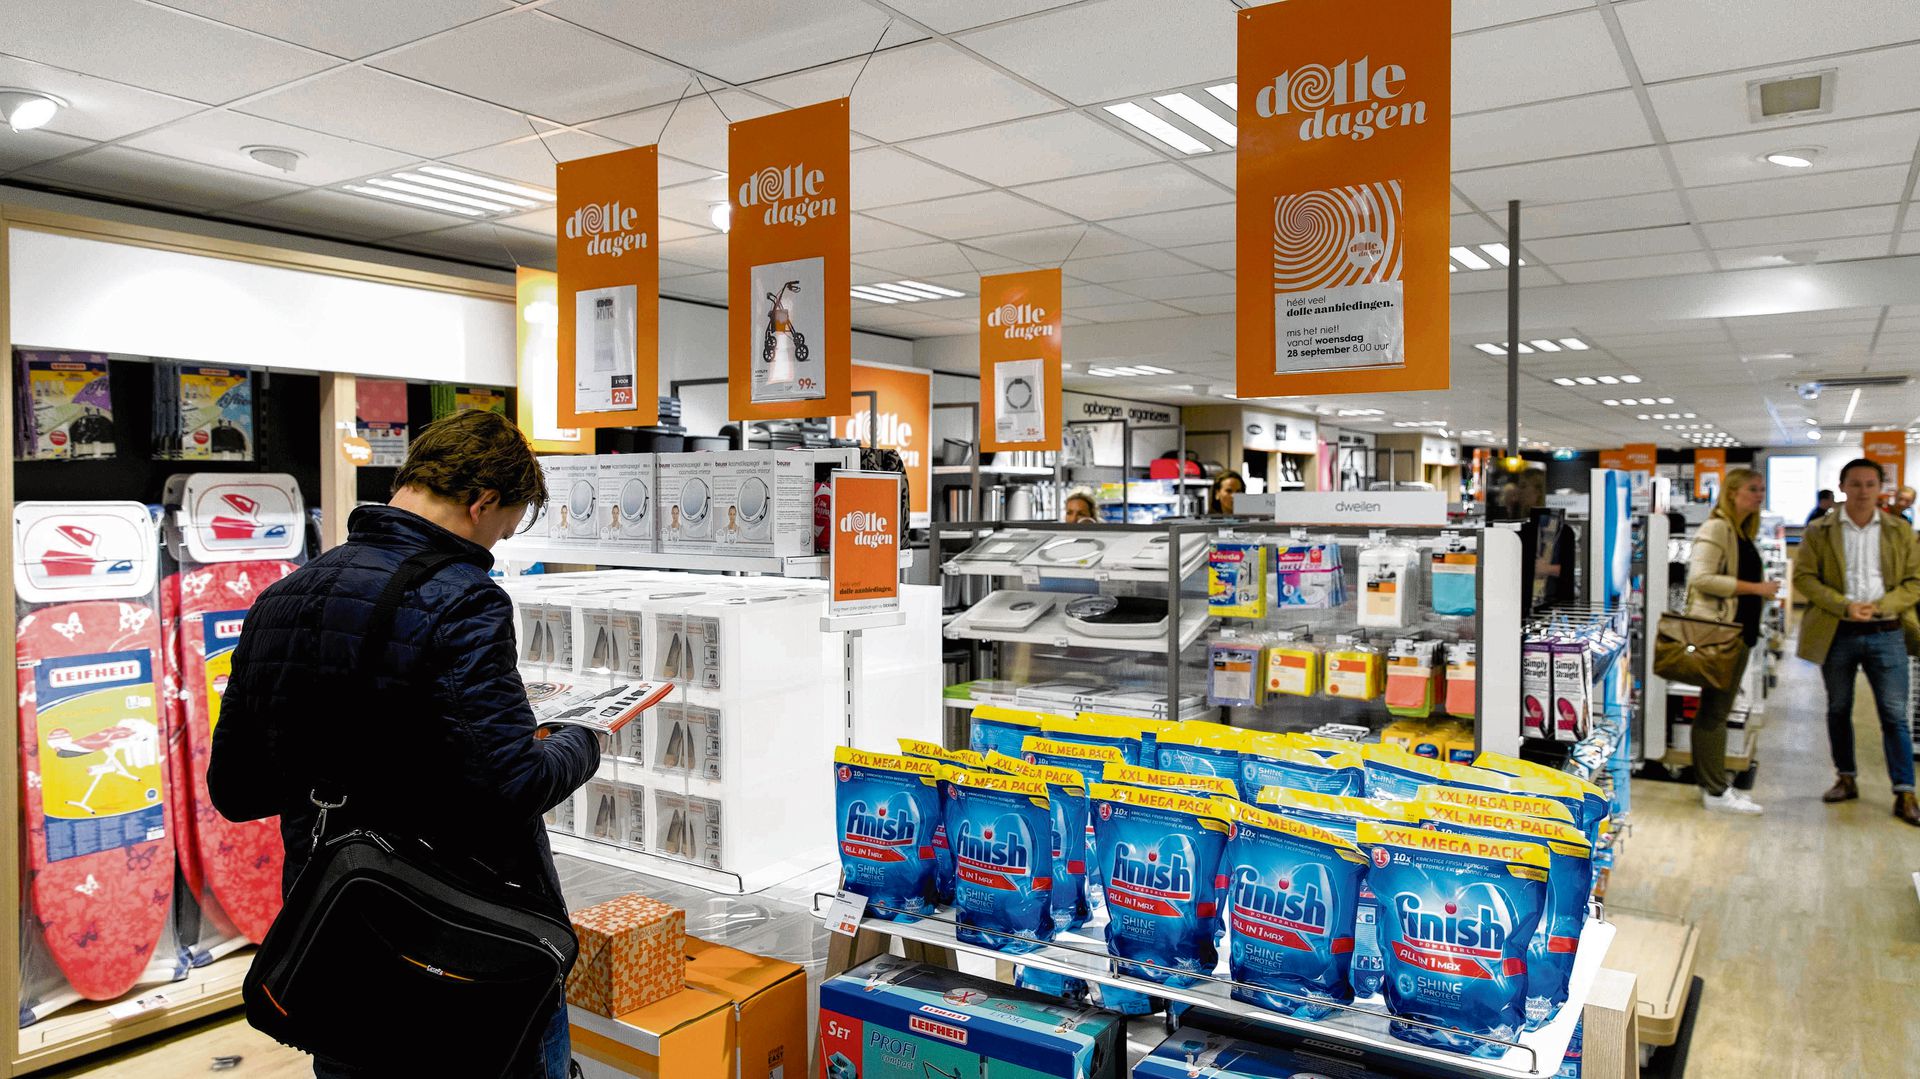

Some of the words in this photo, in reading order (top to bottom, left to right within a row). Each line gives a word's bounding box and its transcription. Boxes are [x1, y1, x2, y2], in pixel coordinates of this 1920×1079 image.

[1255, 55, 1407, 118] dolle
[1299, 100, 1427, 141] dagen
[738, 161, 824, 208] dolle
[565, 200, 638, 239] dolle
[763, 197, 838, 227] dagen
[586, 228, 649, 257] dagen
[1286, 306, 1313, 317] dolle
[1314, 300, 1394, 315] aanbiedingen.
[1307, 295, 1326, 305] veel
[987, 303, 1046, 327] dolle
[1004, 323, 1054, 341] dagen
[1286, 329, 1301, 337] mis
[1303, 327, 1317, 336] het
[1320, 324, 1340, 334] niet!
[1287, 337, 1313, 347] vanaf
[1315, 334, 1364, 345] woensdag
[1287, 350, 1298, 358] 28
[1300, 346, 1350, 357] september
[1352, 343, 1372, 353] 8.00
[1373, 342, 1389, 351] uur
[1335, 501, 1381, 512] dweilen
[840, 510, 888, 533] dolle
[854, 532, 893, 549] dagen
[54, 664, 136, 683] LEIFHEIT
[1523, 659, 1547, 670] Simply
[1523, 668, 1547, 678] Straight
[1554, 661, 1579, 671] Simply
[1555, 670, 1579, 680] Straight
[912, 742, 932, 754] XXL
[1034, 741, 1055, 754] XXL
[1056, 745, 1086, 758] MEGA
[1089, 749, 1116, 760] PACK
[849, 752, 870, 765] XXL
[872, 757, 901, 769] MEGA
[904, 761, 934, 773] PACK
[994, 757, 1013, 773] XXL
[1045, 771, 1074, 784] PACK
[1120, 768, 1143, 782] XXL
[1148, 772, 1184, 786] MEGA
[1190, 777, 1225, 791] PACK
[1258, 767, 1284, 777] SHINE
[974, 777, 1007, 791] MEGA
[1010, 781, 1043, 793] PACK
[1138, 793, 1174, 808] MEGA
[1177, 798, 1213, 814] PACK
[1436, 789, 1462, 805] XXL
[1466, 794, 1508, 811] MEGA
[1513, 801, 1552, 815] PACK
[846, 800, 914, 841] finish
[1114, 807, 1128, 816] 10x
[1267, 816, 1308, 836] MEGA
[1433, 806, 1463, 823] XXL
[1468, 813, 1516, 830] MEGA
[1520, 822, 1565, 837] PACK
[1240, 827, 1256, 838] 10x
[845, 846, 857, 854] ALL
[858, 847, 866, 855] IN
[957, 818, 1027, 869] finish
[1383, 829, 1417, 847] XXL
[1421, 836, 1472, 854] MEGA
[1478, 843, 1524, 860] PACK
[1393, 852, 1412, 863] 10x
[857, 864, 885, 875] SHINE
[1112, 842, 1191, 893] finish
[965, 887, 995, 903] SHINE
[970, 898, 994, 908] PROTECT
[1109, 893, 1122, 903] ALL
[1124, 897, 1132, 905] IN
[1132, 898, 1136, 907] 1
[1137, 902, 1155, 911] MAX
[1233, 864, 1327, 928] finish
[1122, 914, 1156, 931] SHINE
[1250, 911, 1299, 928] POWERBALL
[1395, 891, 1505, 950] finish
[1126, 926, 1155, 936] PROTECT
[1233, 918, 1245, 931] ALL
[1246, 924, 1256, 935] IN
[1258, 927, 1263, 936] 1
[1263, 931, 1284, 942] MAX
[1245, 943, 1285, 963] SHINE
[1419, 942, 1476, 954] POWERBALL
[1249, 955, 1282, 969] PROTECT
[1400, 949, 1417, 962] ALL
[1418, 958, 1429, 968] IN
[1430, 957, 1436, 968] 1
[1437, 963, 1461, 972] MAX
[1417, 976, 1463, 995] SHINE
[1423, 989, 1461, 1001] PROTECT
[911, 1018, 965, 1041] LEIFHEIT
[870, 1030, 918, 1060] PROFI
[881, 1054, 914, 1070] compact
